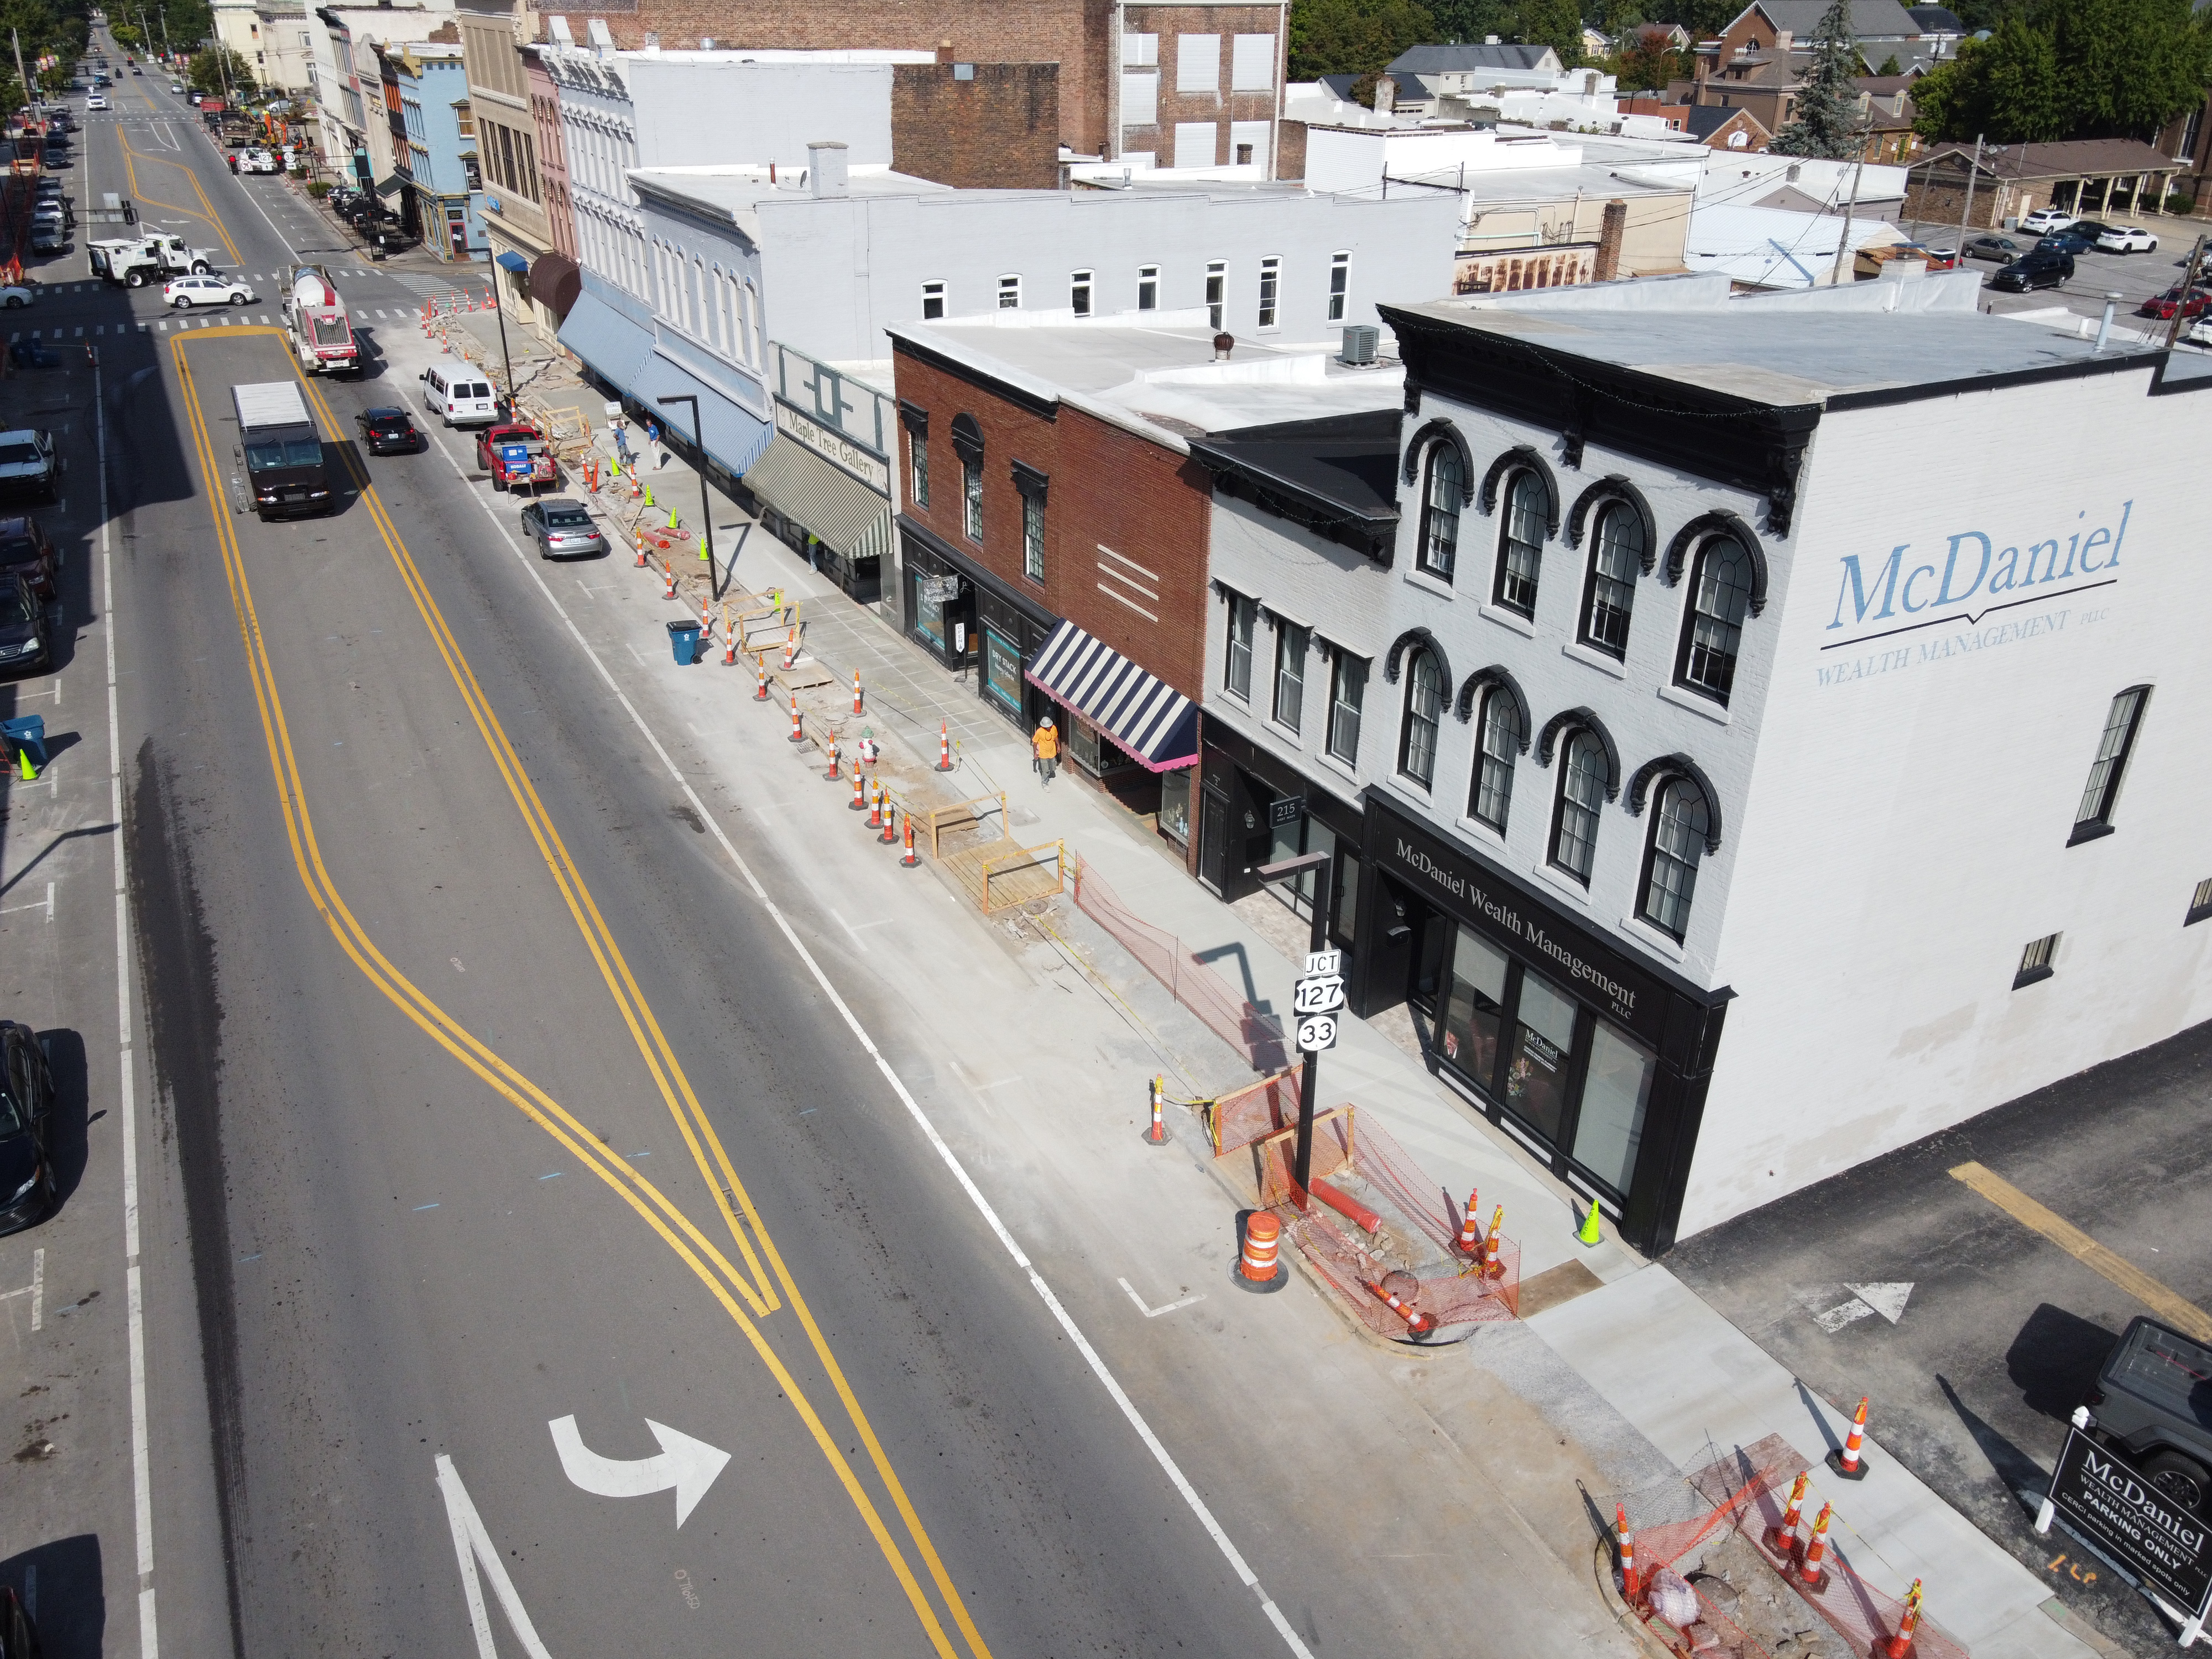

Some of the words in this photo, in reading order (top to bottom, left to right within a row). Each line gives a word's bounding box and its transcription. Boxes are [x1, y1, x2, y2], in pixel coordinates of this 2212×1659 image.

[789, 411, 815, 443] Maple
[816, 427, 837, 456] Tree
[839, 442, 874, 481] Gallery
[1826, 499, 2133, 630] McDaniel
[992, 649, 1002, 662] DRY
[1002, 657, 1017, 675] STACK
[1815, 647, 1909, 687] WEALTH
[1917, 609, 2071, 664] MANAGEMENT
[2080, 607, 2110, 625] PLLC
[1277, 803, 1295, 817] 215
[1396, 838, 1465, 899] McDaniel
[1469, 884, 1521, 935] Wealth
[1525, 921, 1636, 1009] Management
[1306, 956, 1337, 973] JCT
[1301, 983, 1339, 1007] 127
[1611, 1001, 1631, 1020] PLLC
[1302, 1023, 1332, 1044] 33
[1526, 1030, 1558, 1058] McDaniel
[1583, 1207, 1595, 1236] POLICE
[2082, 1448, 2205, 1554] McDaniel
[2061, 1491, 2087, 1515] CERCI
[2086, 1512, 2114, 1537] parking
[2114, 1532, 2123, 1543] in
[2124, 1538, 2152, 1563] marked
[2151, 1562, 2173, 1584] spots
[2173, 1580, 2190, 1597] only
[2080, 1473, 2120, 1510] WEALTH
[2120, 1506, 2195, 1567] MANAGEMENT
[2194, 1566, 2208, 1579] PLLC
[2084, 1490, 2141, 1541] PARKING
[2144, 1538, 2182, 1571] ONLY
